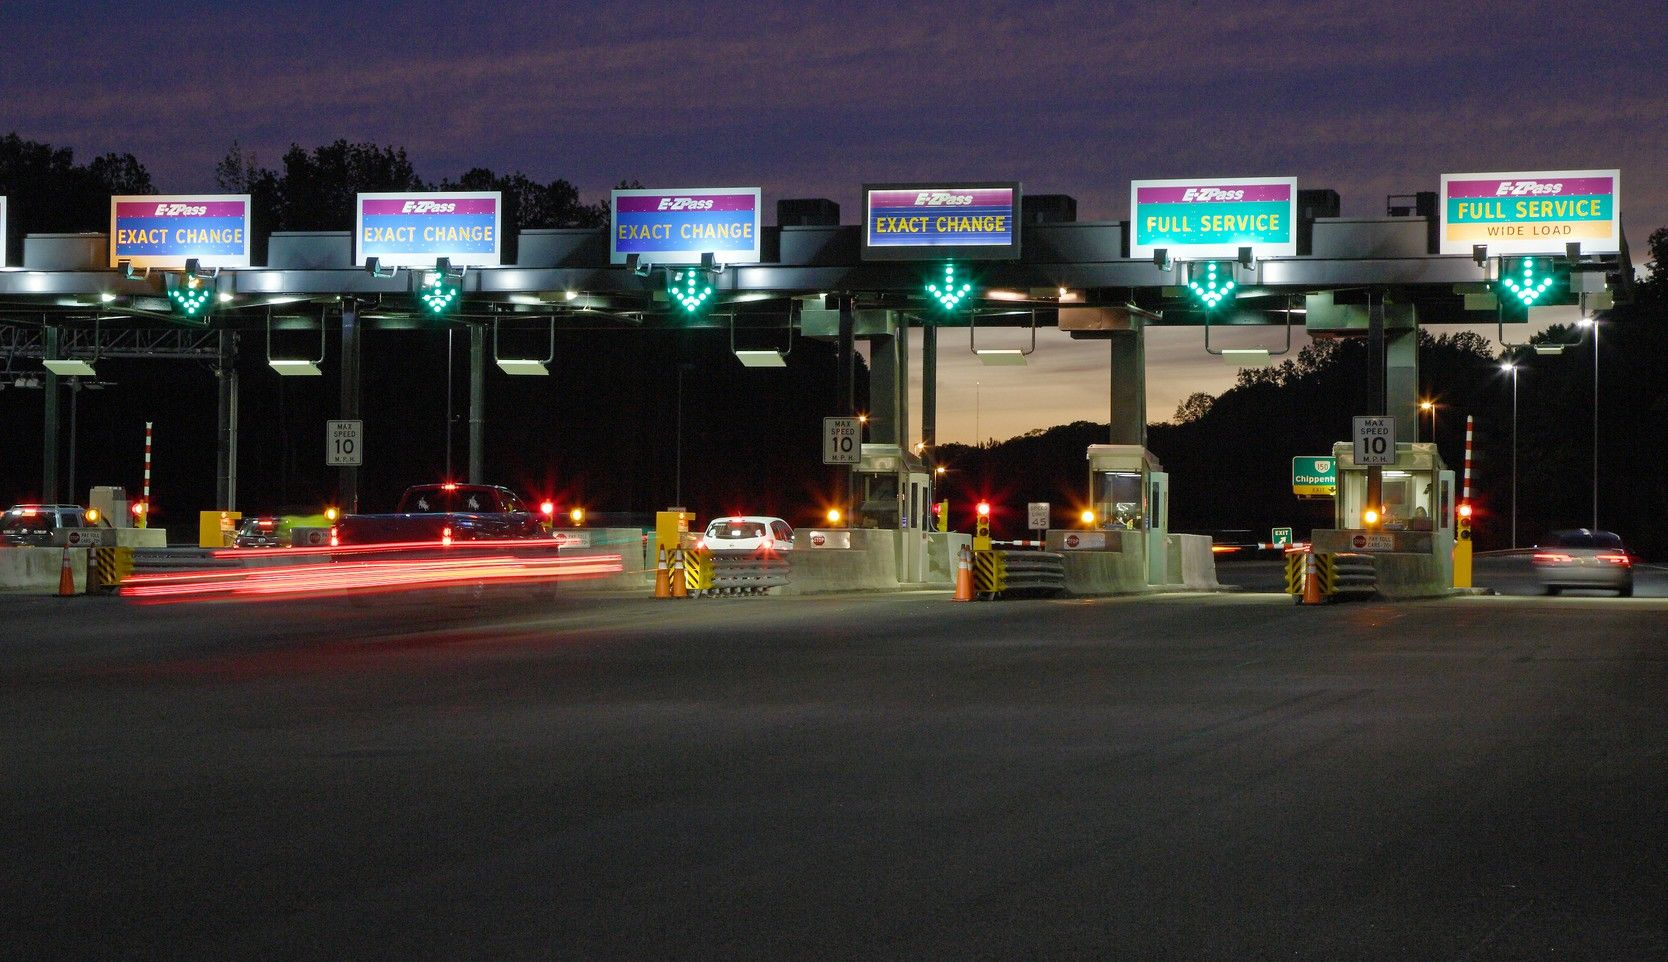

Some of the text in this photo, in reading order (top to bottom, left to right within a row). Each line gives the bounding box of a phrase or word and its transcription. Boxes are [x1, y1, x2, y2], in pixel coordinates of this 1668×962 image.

[1182, 188, 1245, 202] E-ZPass
[1496, 181, 1563, 196] E-ZPass
[657, 198, 714, 211] E-ZPass
[914, 192, 974, 206] E-ZPass
[155, 204, 207, 216] E-ZPass
[402, 201, 456, 213] E-ZPass
[1458, 200, 1601, 219] FULL SERVICE
[877, 215, 1006, 233] EXACT CHANGE
[1147, 214, 1279, 232] FULL SERVICE
[1487, 225, 1572, 236] WIDE LOAD
[118, 229, 242, 244] EXACT CHANGE
[364, 226, 493, 242] EXACT CHANGE
[618, 223, 752, 239] EXACT CHANGE
[333, 430, 356, 438] SPEED
[1360, 427, 1389, 435] SPEED
[335, 439, 354, 454] 10
[832, 436, 853, 452] 10
[1363, 436, 1387, 454] 10
[1032, 518, 1047, 526] 45
